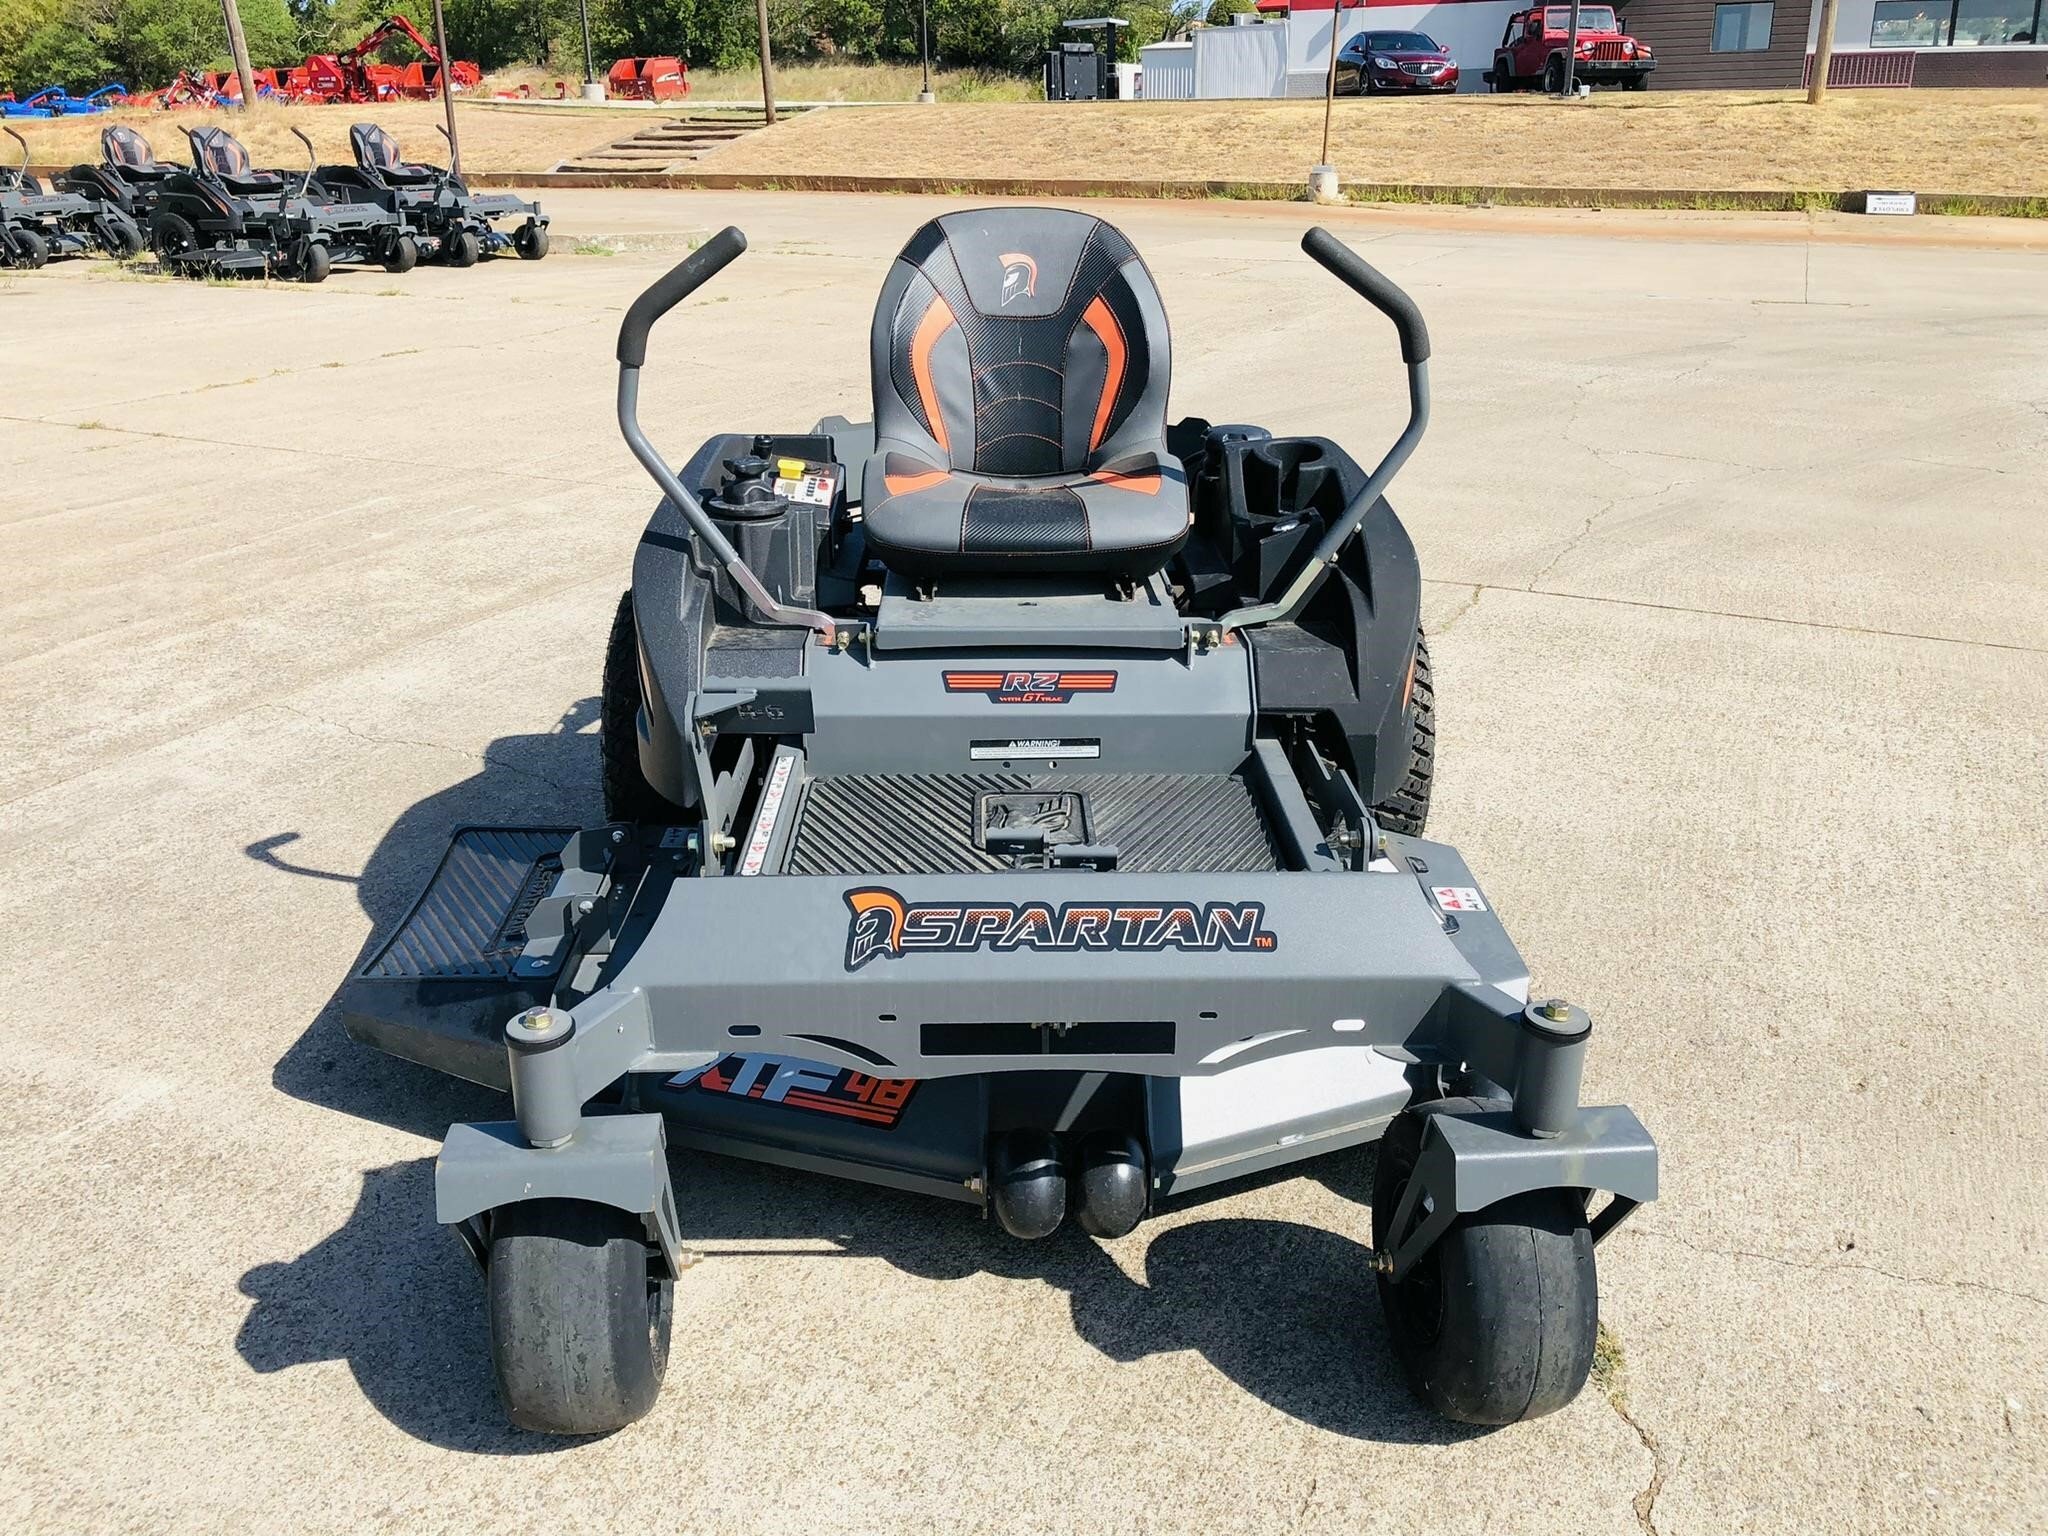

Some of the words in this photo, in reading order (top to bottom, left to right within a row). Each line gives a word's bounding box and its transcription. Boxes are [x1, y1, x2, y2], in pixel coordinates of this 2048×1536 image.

[1002, 672, 1060, 692] RZ
[1016, 739, 1061, 748] WARNING!
[899, 907, 1260, 947] SPARTAN
[1254, 937, 1273, 948] TM
[844, 1070, 917, 1108] 48
